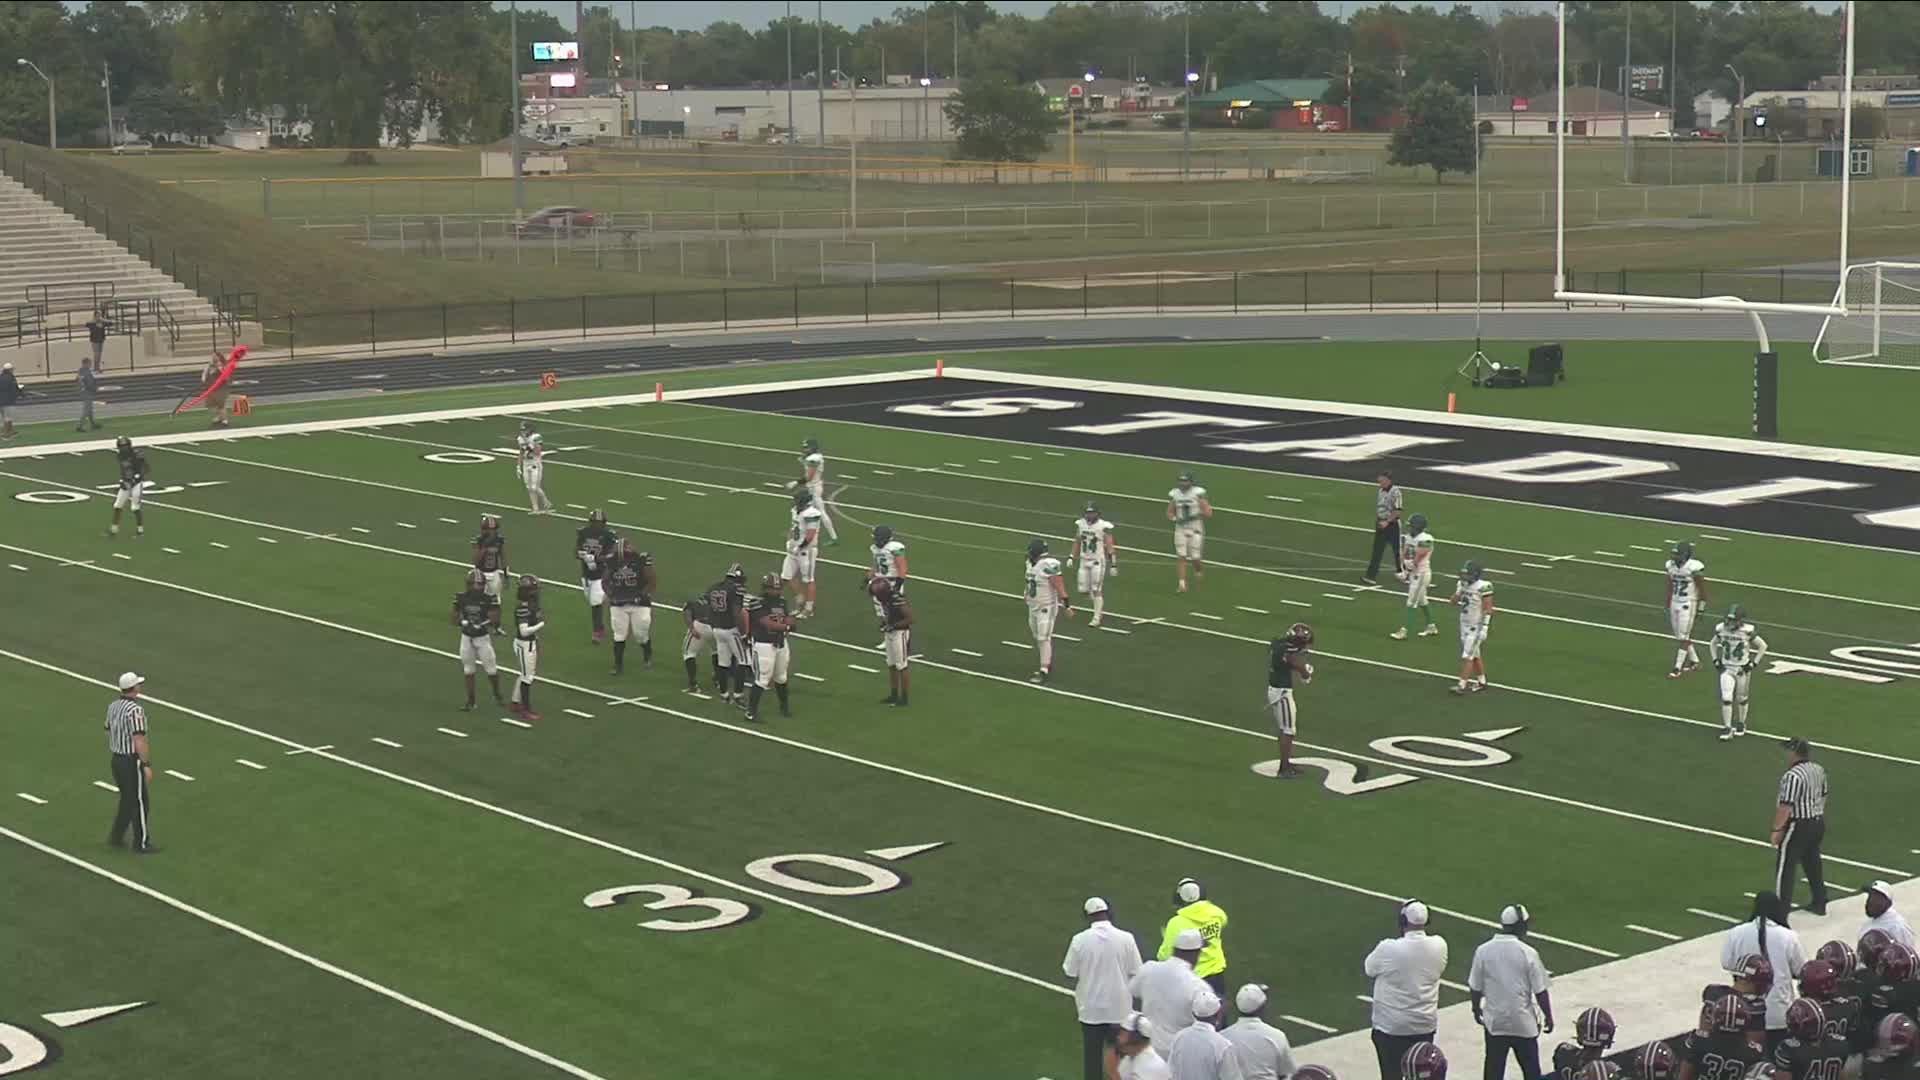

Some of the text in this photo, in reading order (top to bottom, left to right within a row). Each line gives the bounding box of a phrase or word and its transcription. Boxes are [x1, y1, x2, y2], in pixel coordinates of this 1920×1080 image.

[890, 396, 1920, 530] STADI
[1250, 736, 1512, 794] 20
[583, 853, 902, 931] 30
